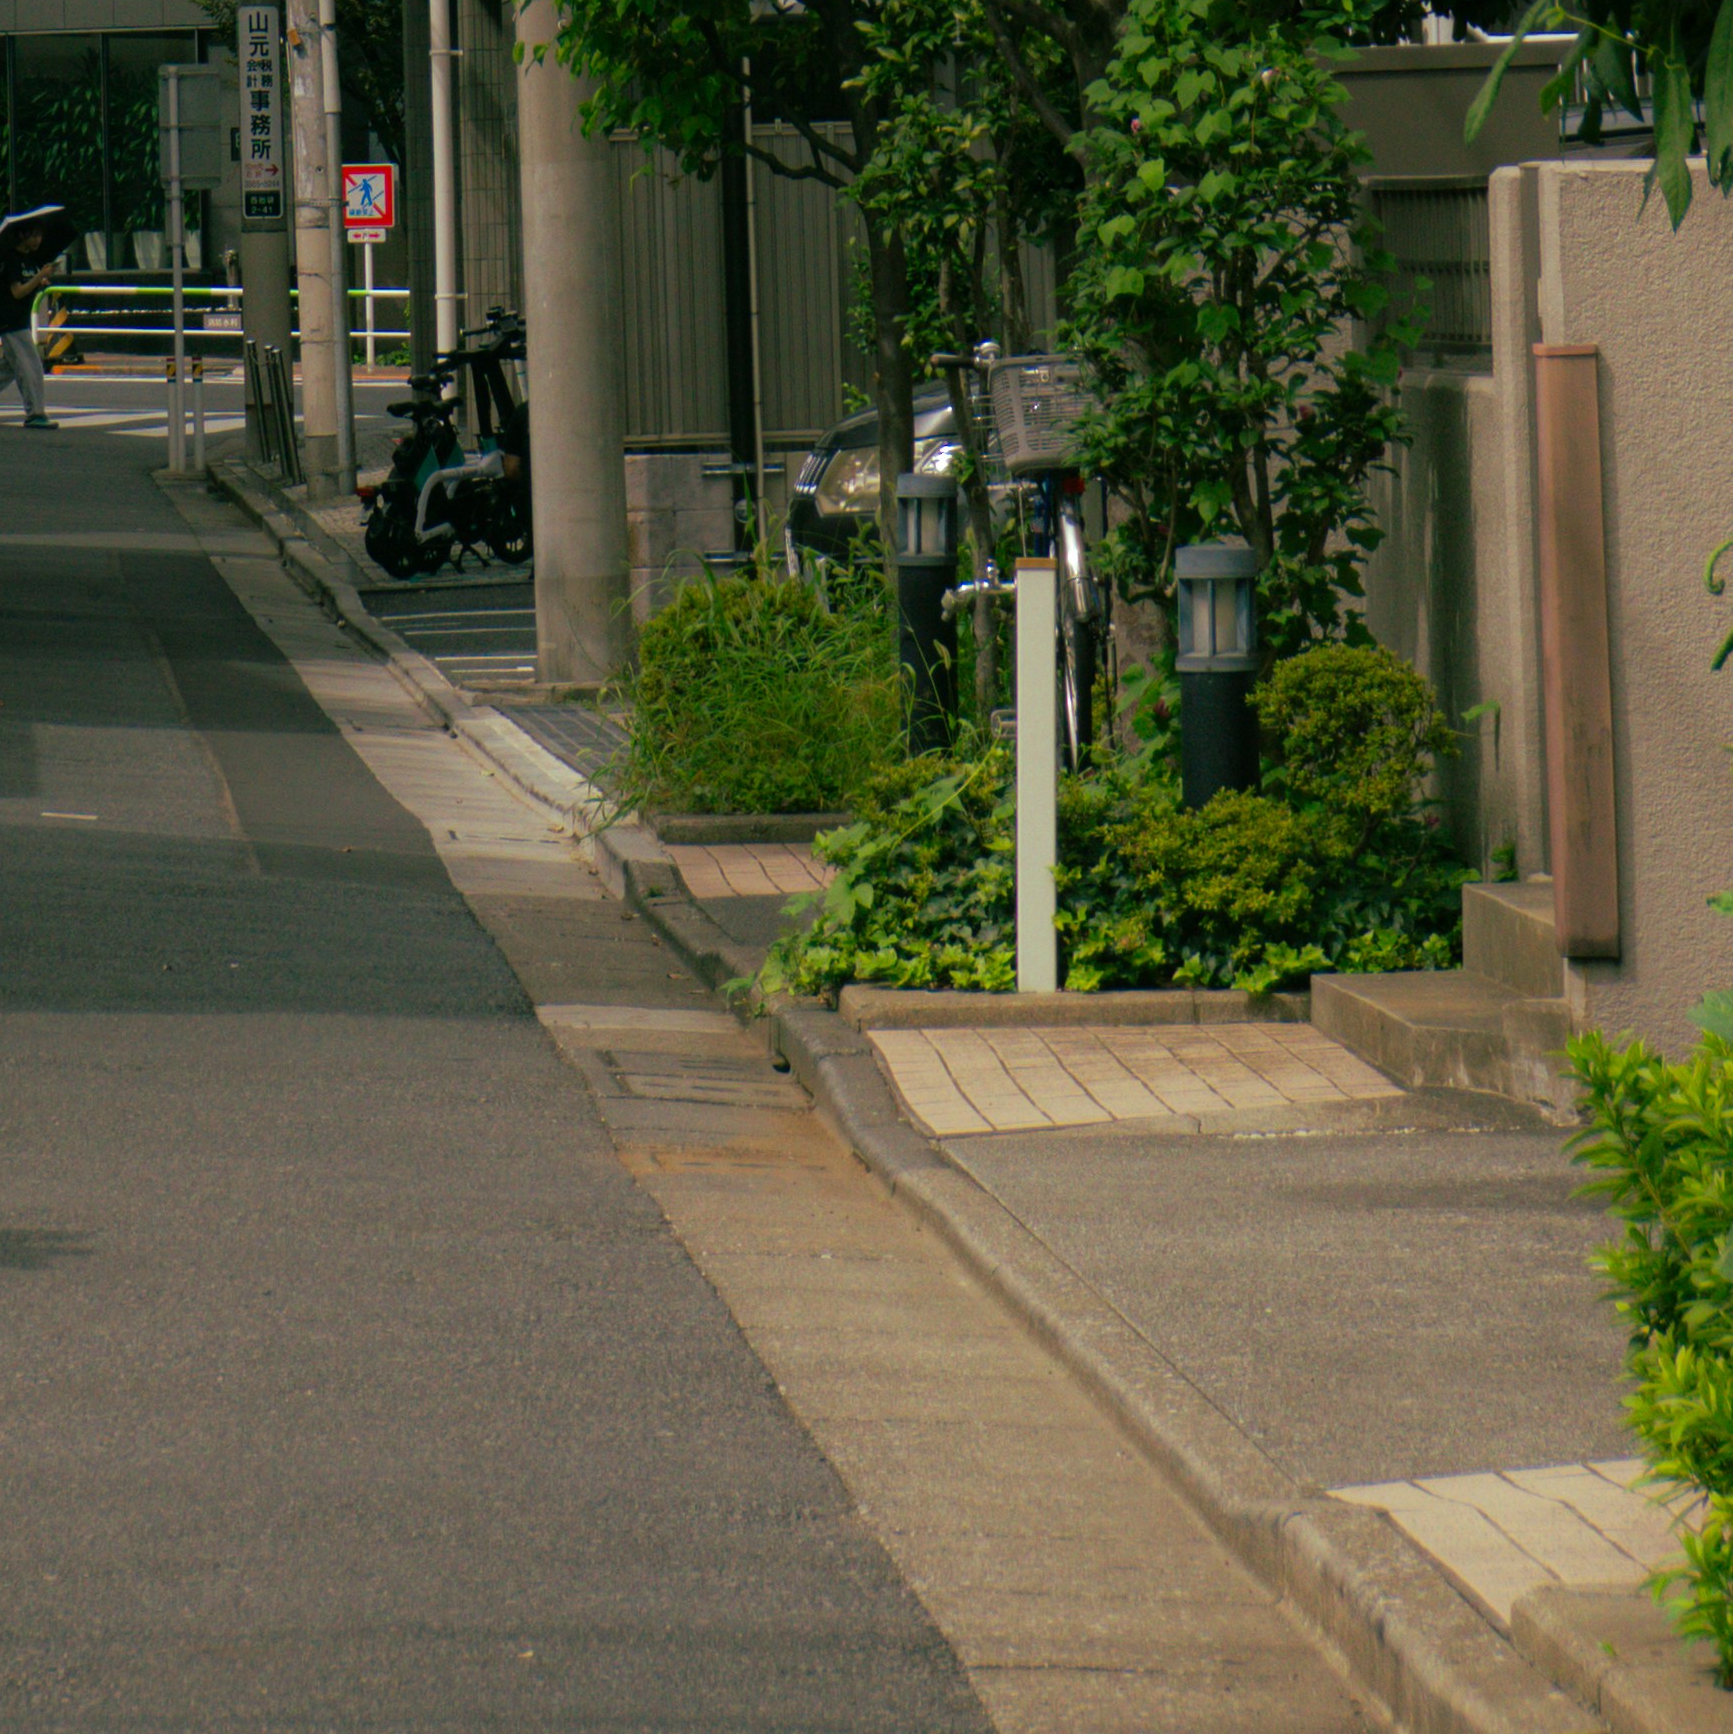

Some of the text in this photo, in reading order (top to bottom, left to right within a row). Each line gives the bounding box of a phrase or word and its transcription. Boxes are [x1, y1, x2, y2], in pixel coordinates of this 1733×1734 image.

[248, 11, 269, 57] 山元
[246, 59, 258, 88] 会計
[260, 59, 274, 88] 税務
[250, 89, 271, 160] 事務所
